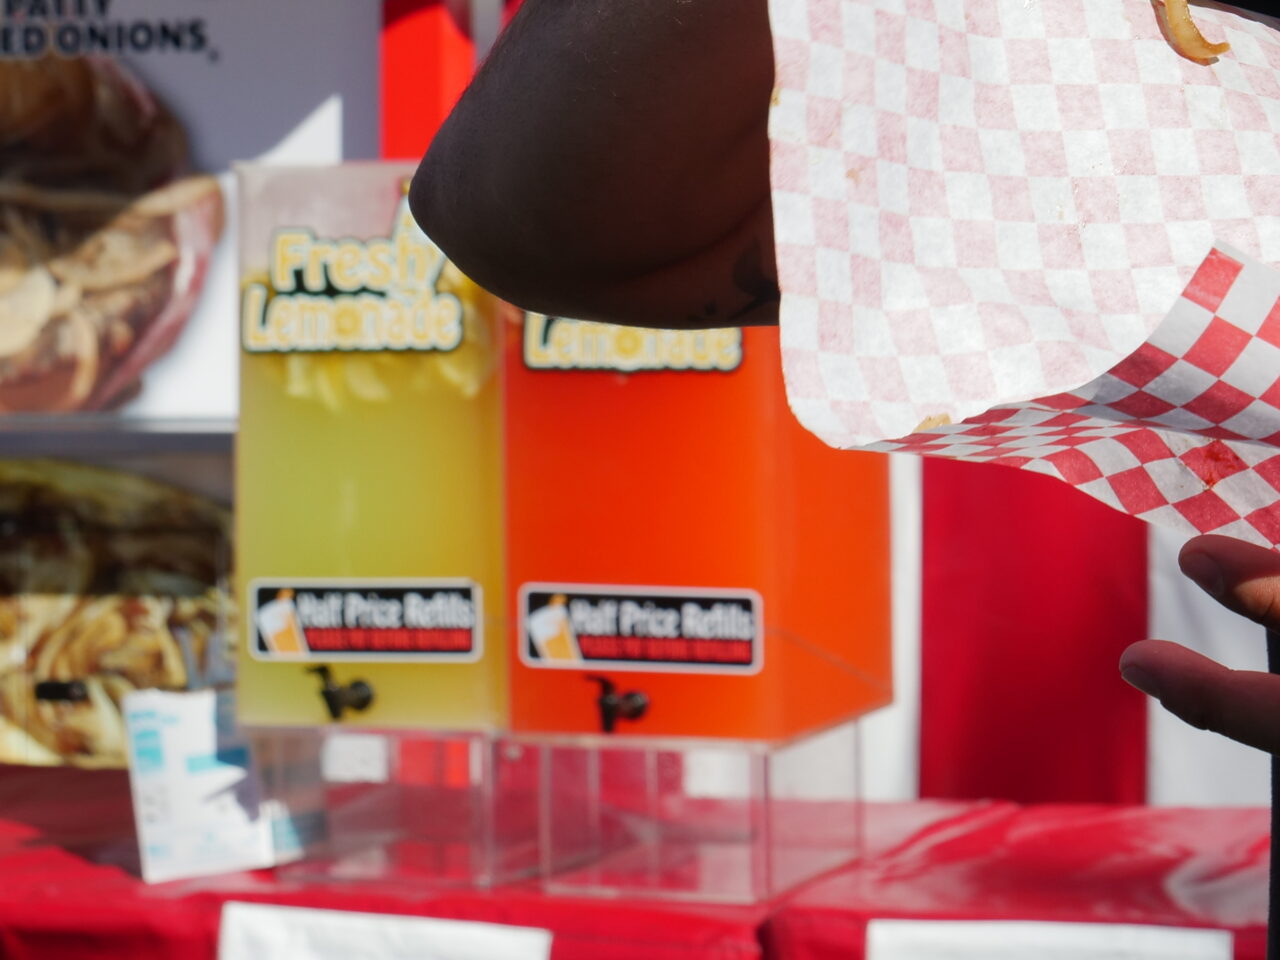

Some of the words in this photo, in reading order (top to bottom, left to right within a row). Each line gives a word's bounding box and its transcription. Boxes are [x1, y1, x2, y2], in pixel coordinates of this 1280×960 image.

[243, 283, 463, 351] Lemonade
[297, 592, 342, 630] Half
[344, 592, 402, 630] Price
[404, 592, 476, 631] Refills
[570, 598, 617, 636] Half
[618, 600, 680, 638] Price
[681, 602, 755, 641] Refills
